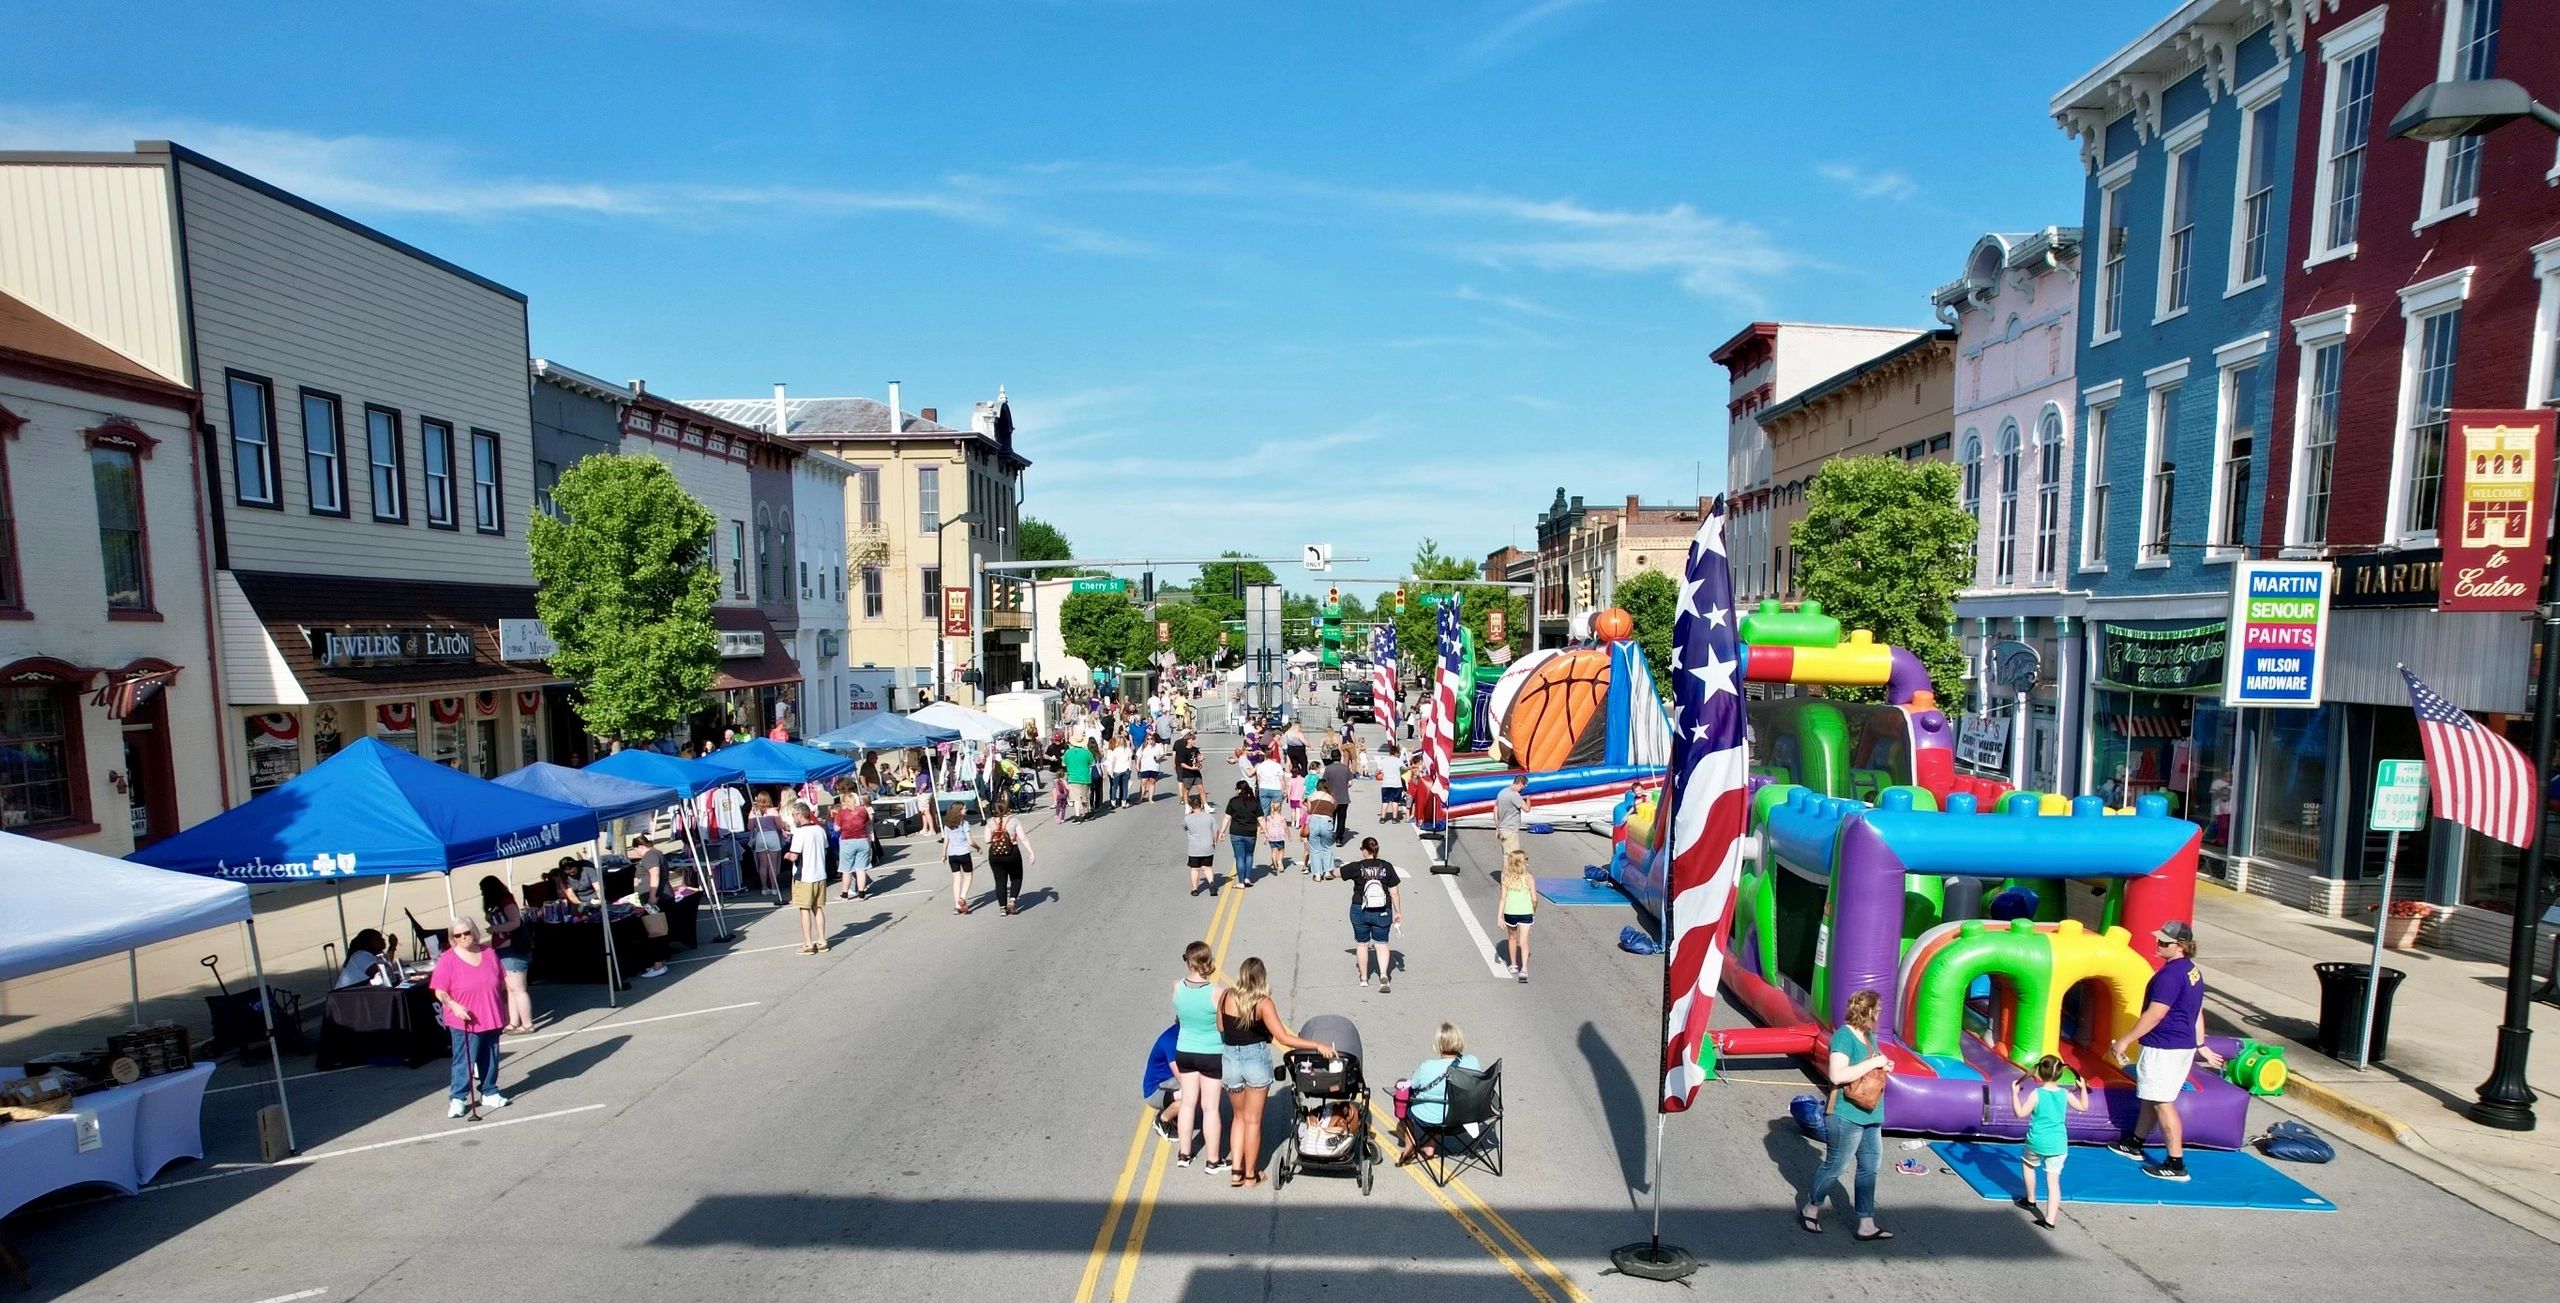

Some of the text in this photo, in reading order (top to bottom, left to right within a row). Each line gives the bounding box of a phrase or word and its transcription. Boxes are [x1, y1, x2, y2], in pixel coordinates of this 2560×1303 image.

[2472, 488, 2524, 498] WELCOME
[2486, 550, 2510, 568] to
[1080, 582, 1106, 591] Cherry
[2253, 577, 2318, 592] MARTIN
[2355, 562, 2443, 595] HARDW
[2454, 568, 2528, 597] Eaton
[2251, 602, 2315, 618] SENOUR
[2248, 628, 2313, 645] PAINTS
[322, 632, 400, 665] JEWELERS
[427, 632, 470, 655] EATON
[2257, 658, 2300, 673] WILSON
[2246, 676, 2308, 690] HARDWARE
[2385, 765, 2391, 783] 1
[495, 834, 541, 858] Anthem
[214, 856, 310, 878] Anthem
